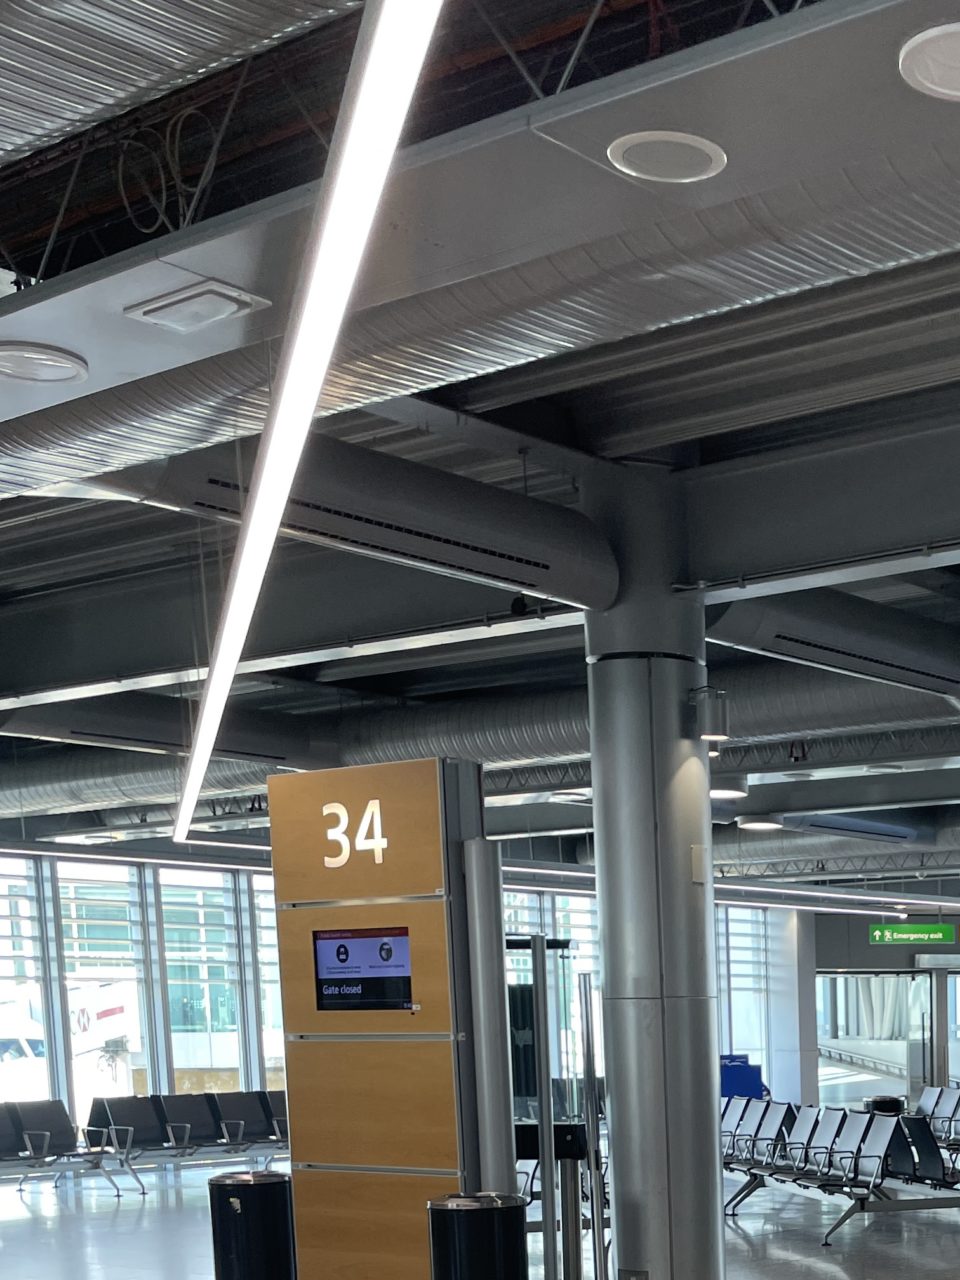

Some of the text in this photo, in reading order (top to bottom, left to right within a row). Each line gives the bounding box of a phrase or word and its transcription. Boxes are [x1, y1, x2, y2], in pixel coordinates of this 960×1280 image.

[322, 799, 387, 868] 34
[893, 932, 929, 940] Emergency
[322, 984, 362, 995] Gate closed
